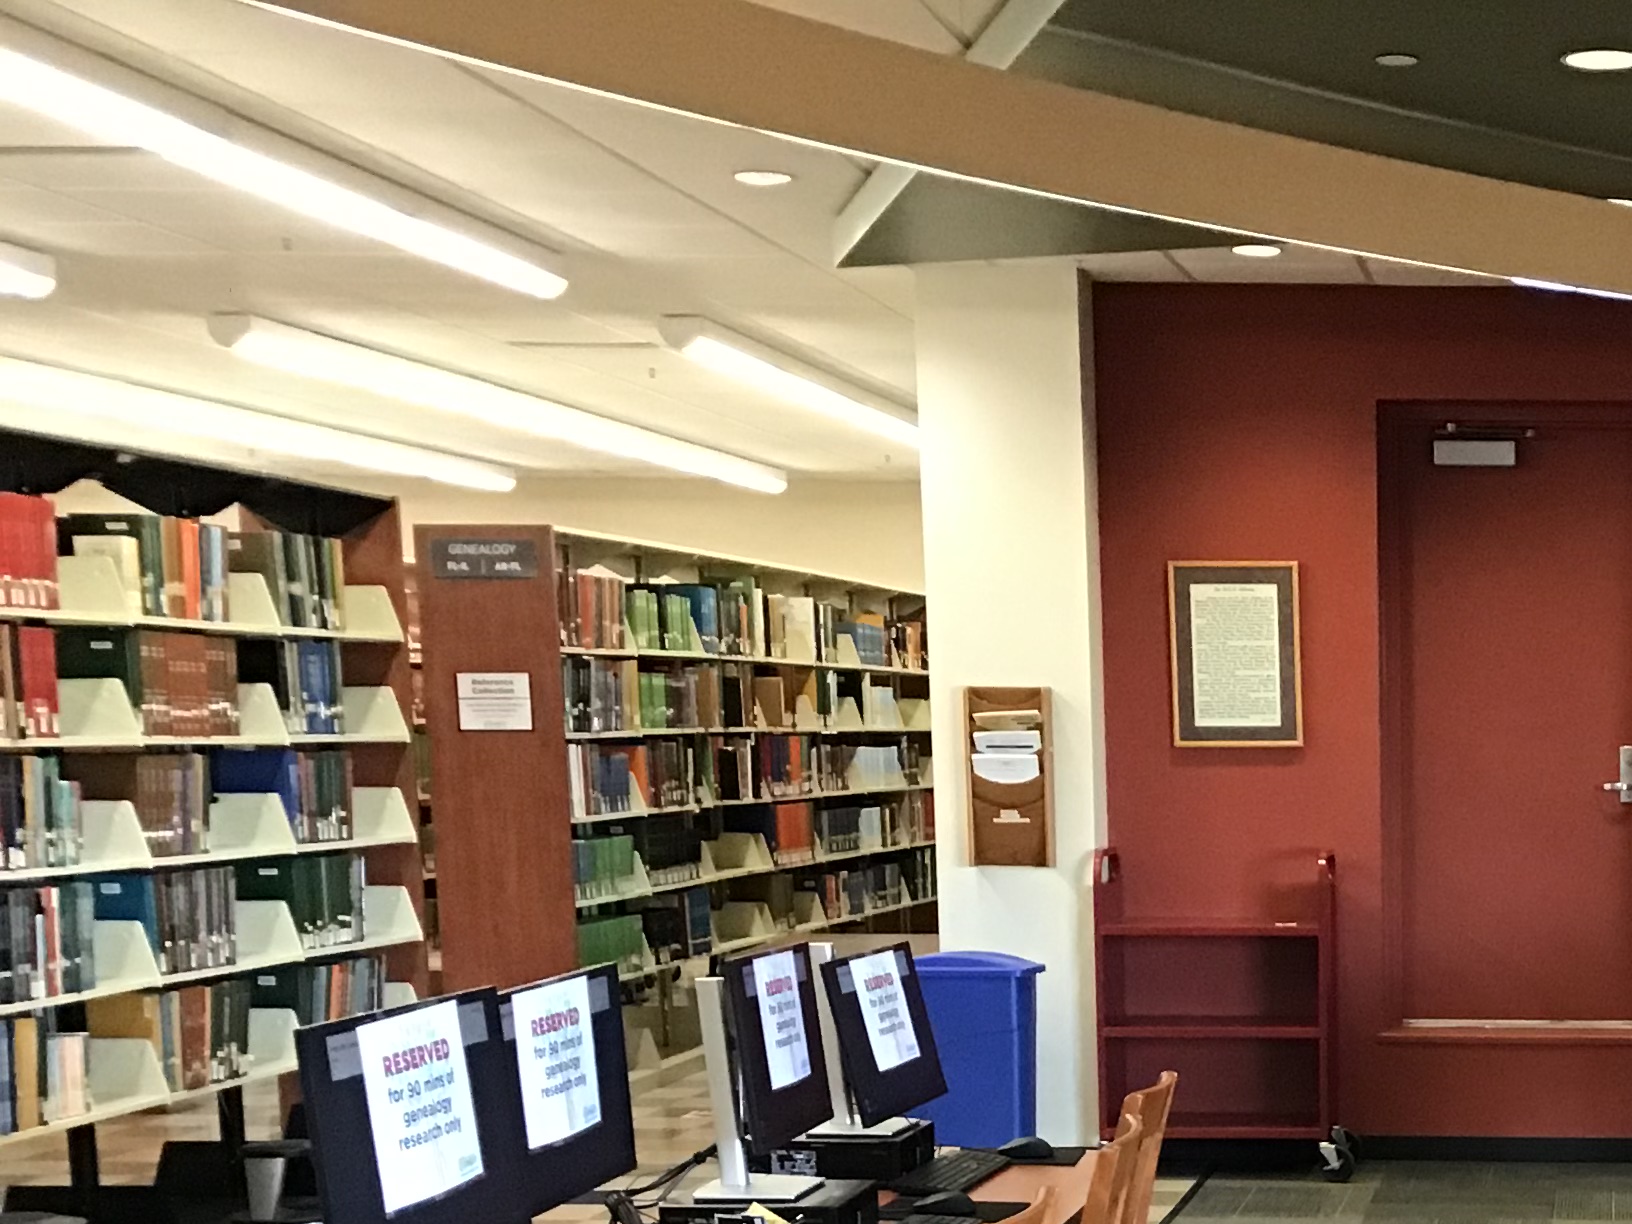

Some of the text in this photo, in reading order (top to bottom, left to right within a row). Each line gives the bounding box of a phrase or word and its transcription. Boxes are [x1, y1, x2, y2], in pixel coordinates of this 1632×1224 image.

[448, 543, 517, 555] GENEALOGY
[530, 1006, 581, 1038] RESERVED
[382, 1037, 451, 1078] RESERVED
[533, 1045, 547, 1061] for
[387, 1087, 405, 1105] for
[406, 1081, 422, 1099] 90
[424, 1073, 446, 1094] mins
[403, 1094, 453, 1128] genealogy
[398, 1115, 463, 1152] research only
